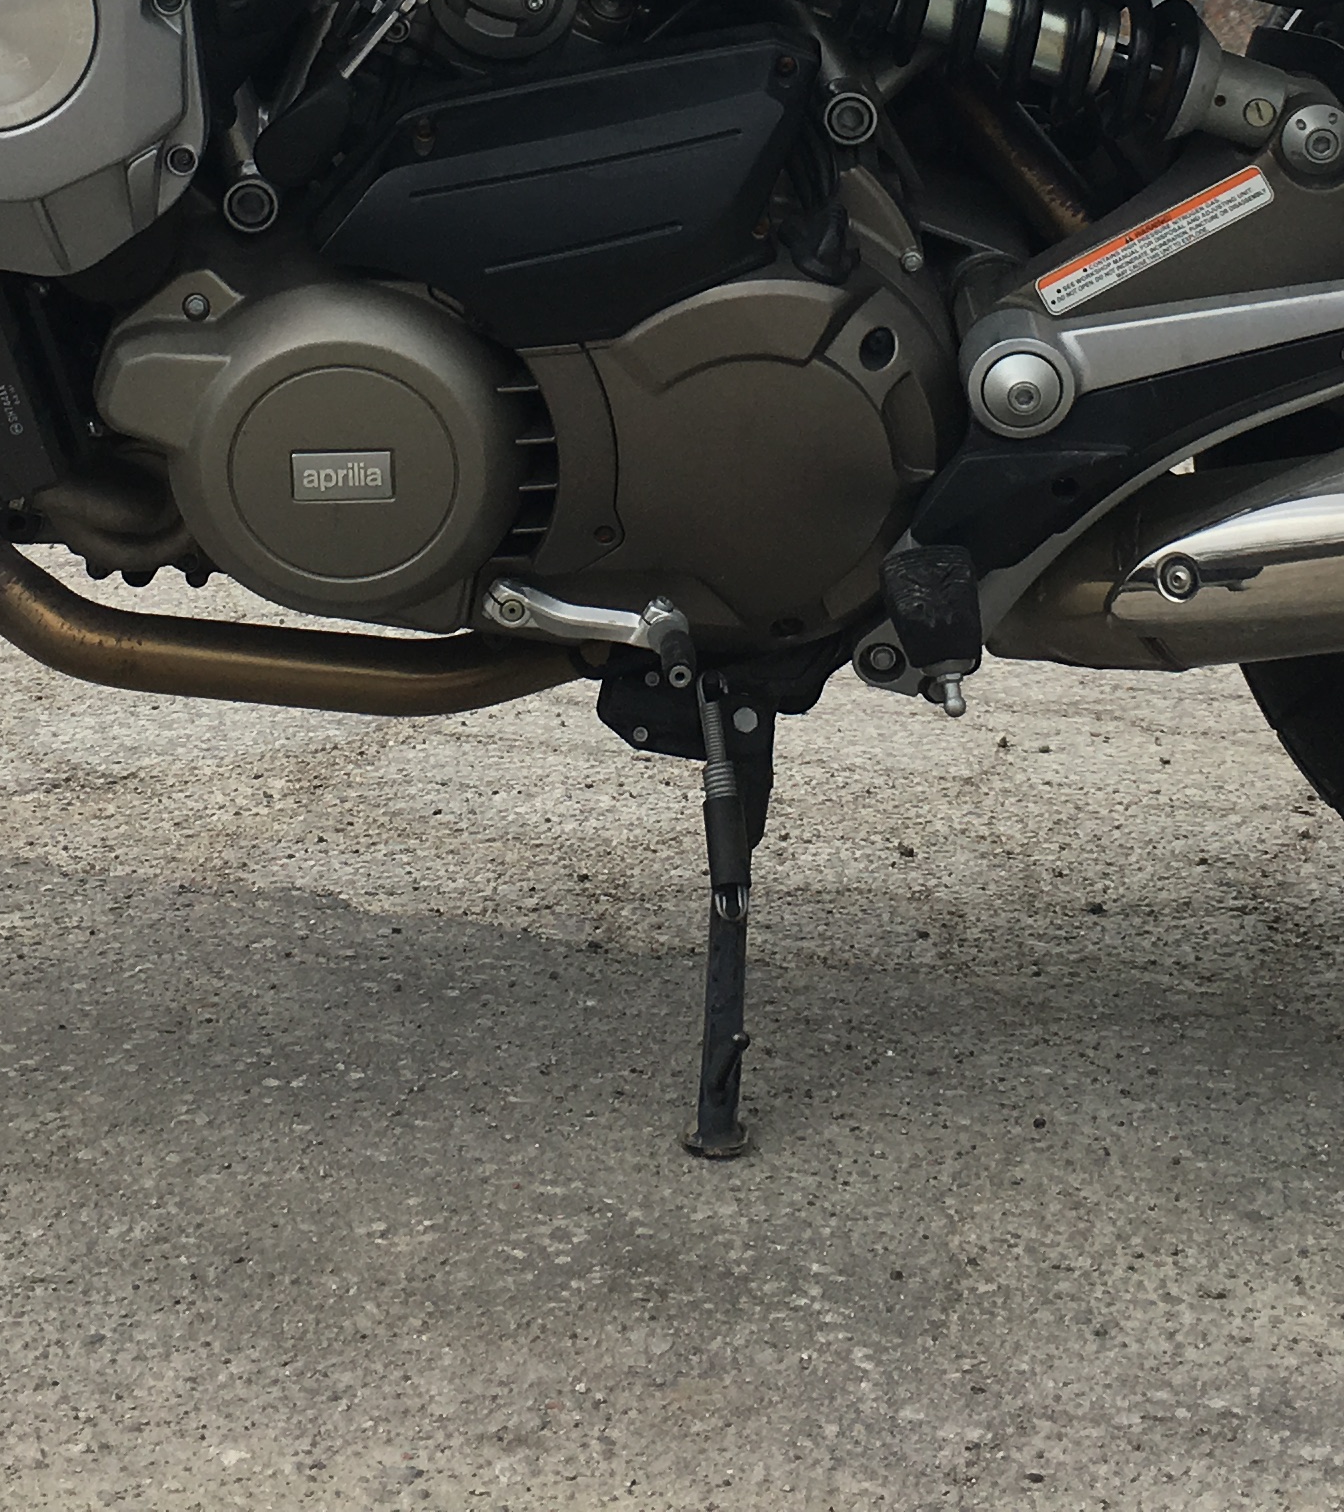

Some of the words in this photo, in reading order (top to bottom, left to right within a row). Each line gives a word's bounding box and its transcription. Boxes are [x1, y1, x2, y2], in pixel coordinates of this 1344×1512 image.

[1062, 282, 1075, 291] SEE
[1076, 262, 1112, 284] WORKSHOP
[302, 462, 382, 492] aprilia
